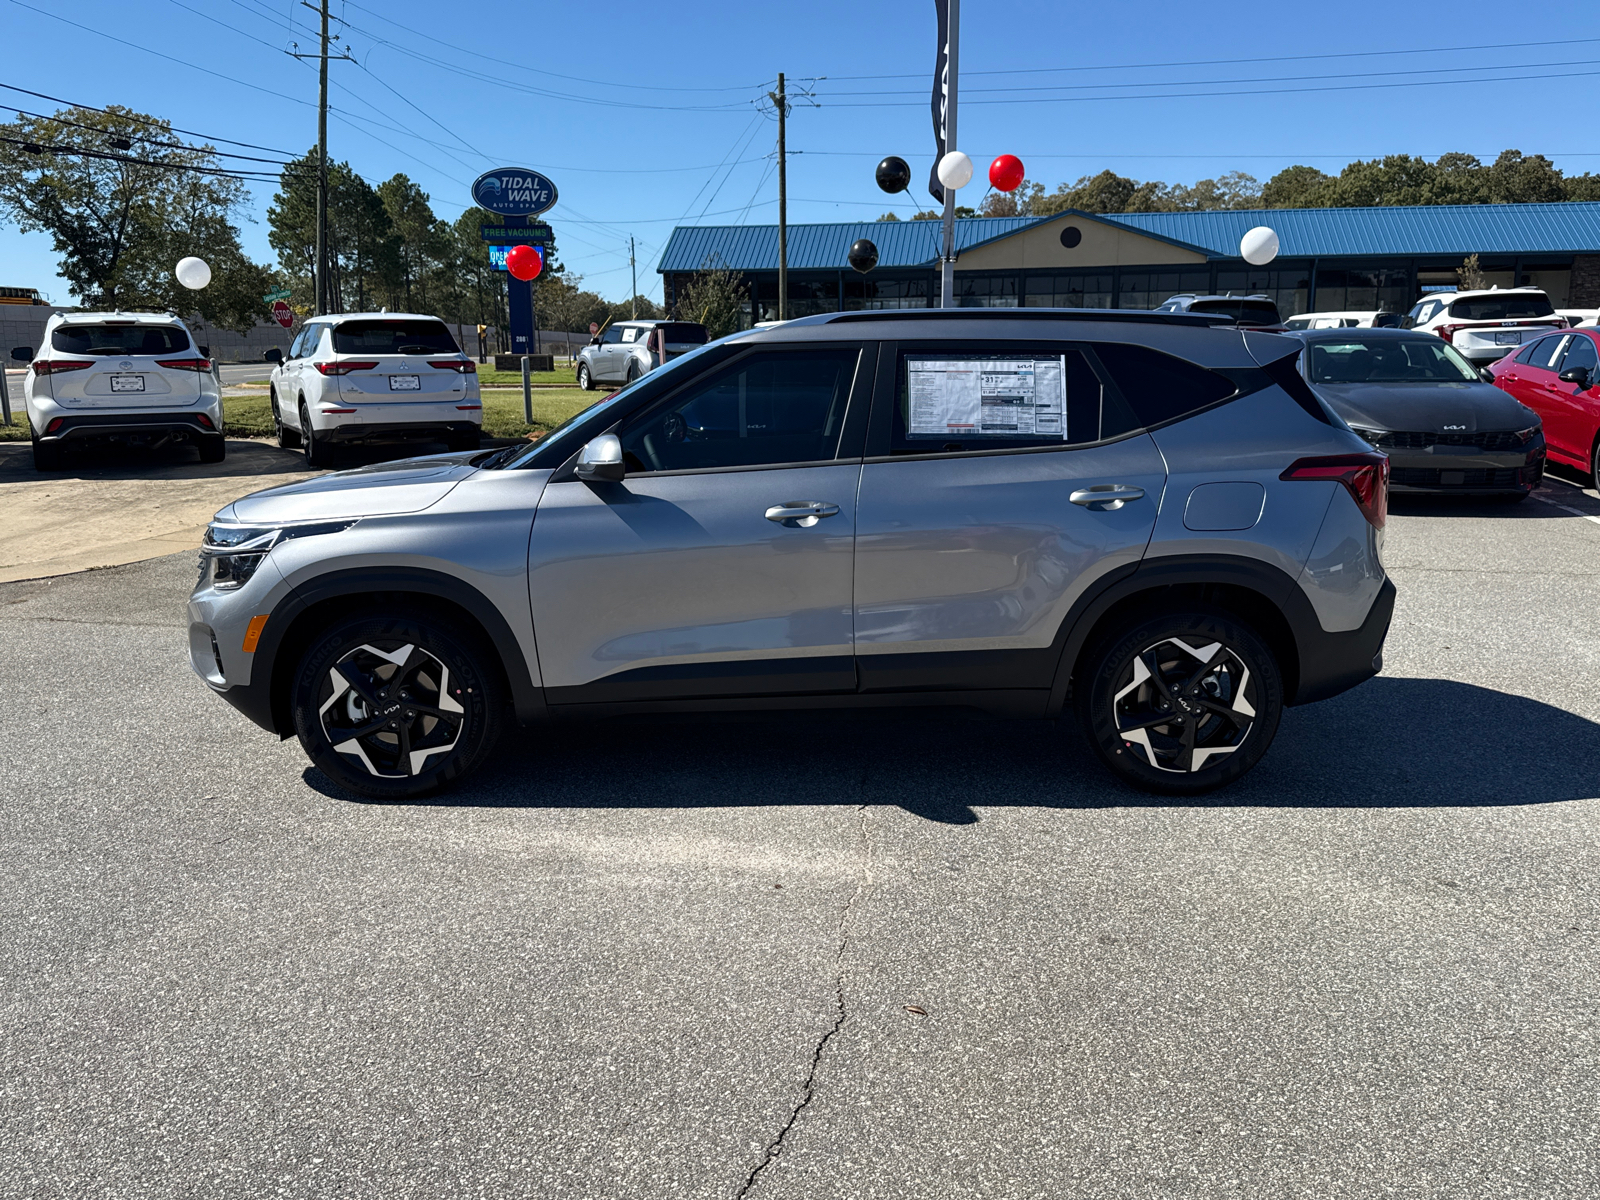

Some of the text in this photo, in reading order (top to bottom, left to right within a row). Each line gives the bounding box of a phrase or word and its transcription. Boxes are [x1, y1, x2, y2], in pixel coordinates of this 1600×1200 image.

[501, 176, 540, 189] TIDAL
[508, 189, 549, 202] WAVE
[507, 229, 547, 237] VACUUMS
[275, 309, 291, 320] STOP
[1102, 630, 1149, 679] KUMHO
[301, 636, 343, 687] KUMHO
